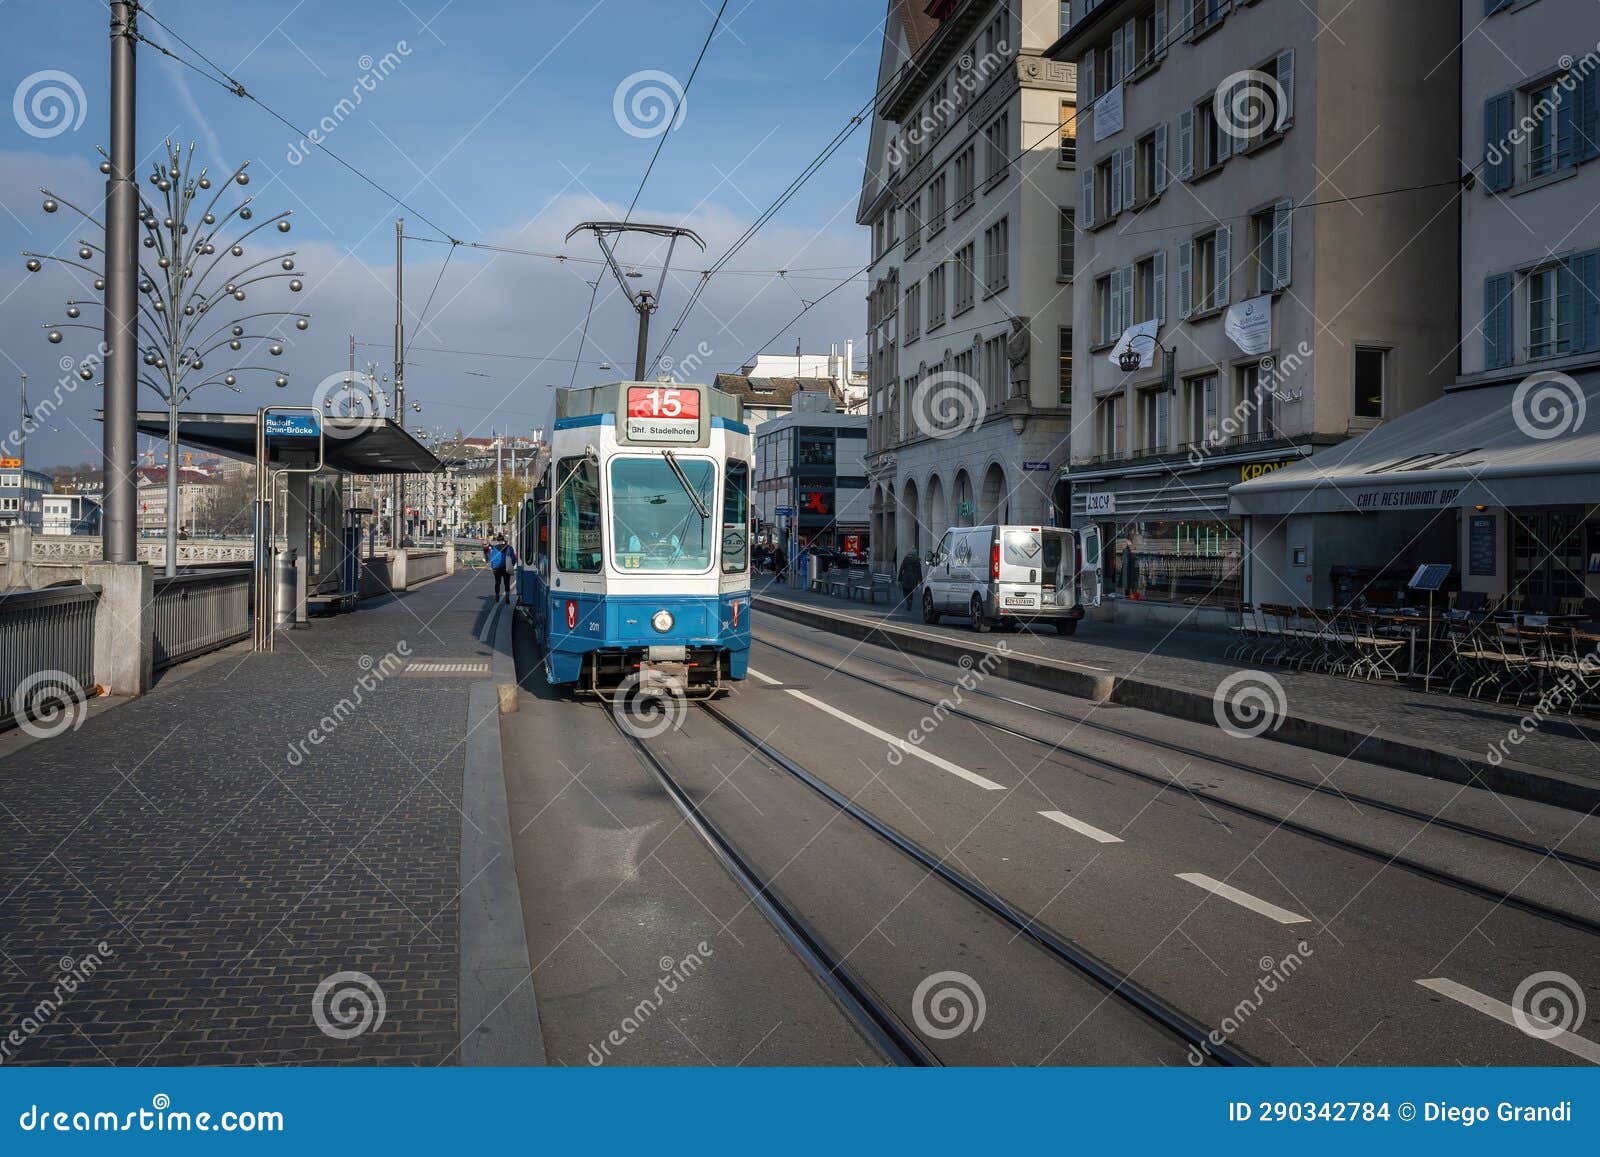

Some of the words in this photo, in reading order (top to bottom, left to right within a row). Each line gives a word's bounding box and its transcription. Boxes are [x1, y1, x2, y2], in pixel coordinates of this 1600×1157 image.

[646, 390, 682, 417] 15
[631, 426, 647, 434] Bhf.
[649, 426, 695, 435] Stadelhofen
[1241, 461, 1296, 482] KRO
[1381, 489, 1438, 506] RESTAURANT
